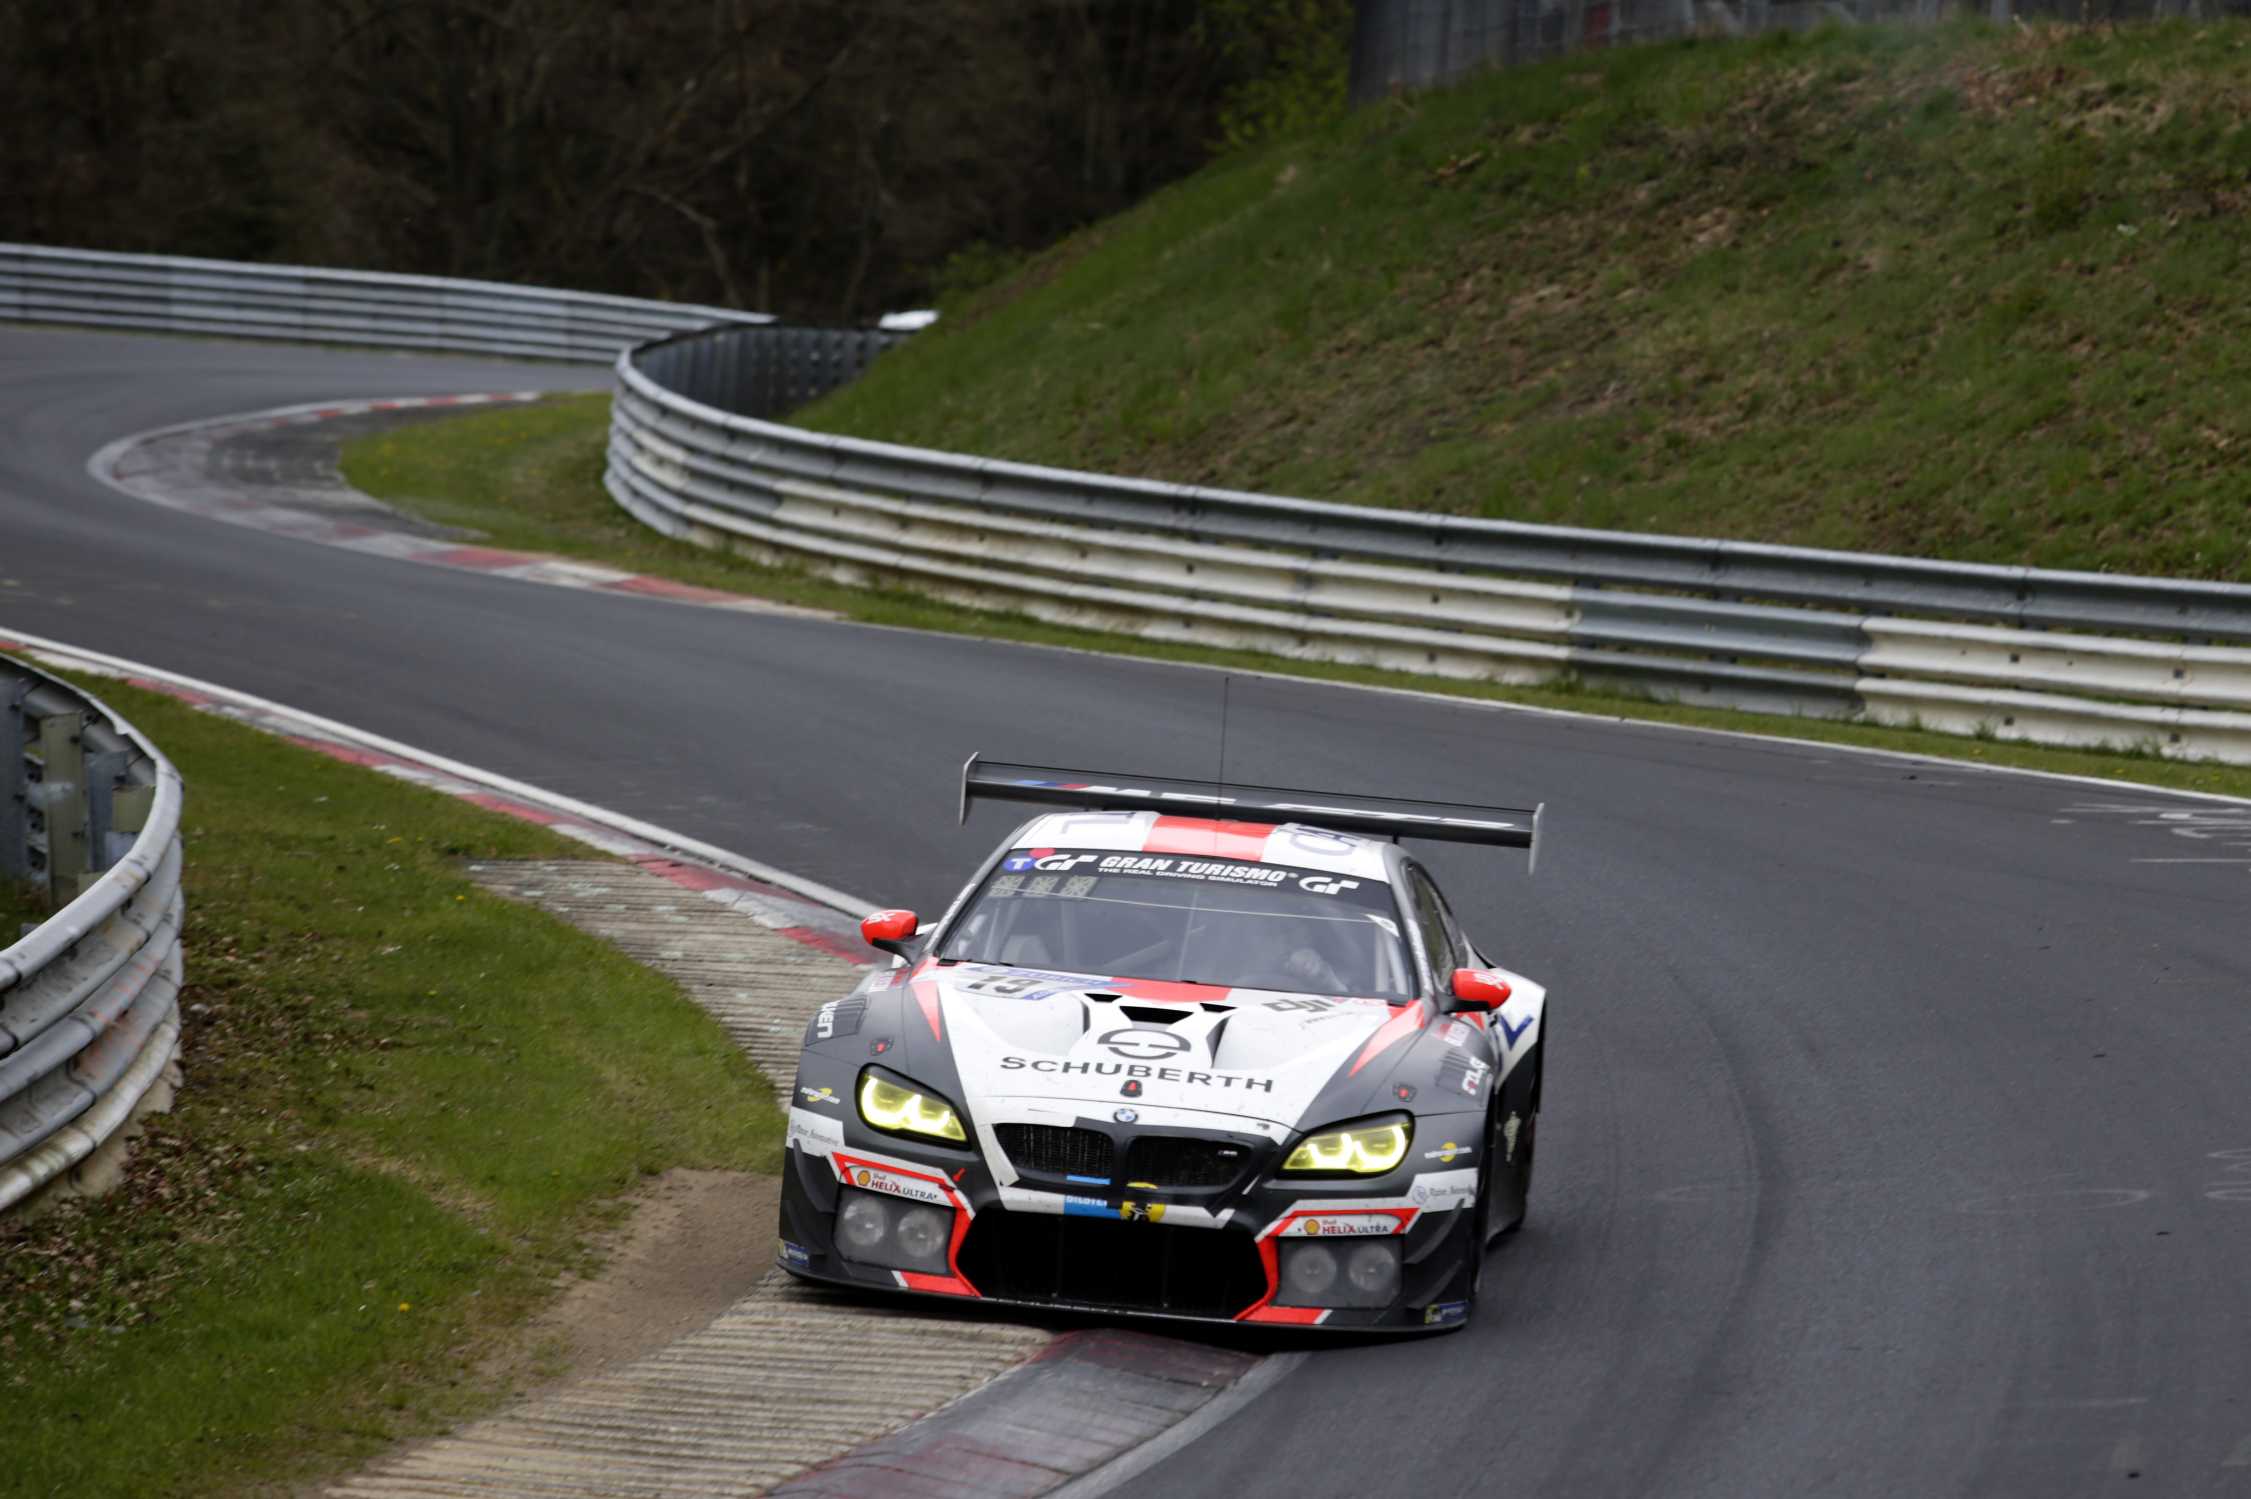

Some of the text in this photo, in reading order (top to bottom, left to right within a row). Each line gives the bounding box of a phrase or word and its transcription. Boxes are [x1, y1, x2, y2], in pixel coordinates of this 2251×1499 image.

[1099, 856, 1174, 871] GRAN
[1000, 1056, 1275, 1093] SCHUBERTH
[871, 1180, 933, 1200] HELIX ULTRA
[1322, 1225, 1389, 1234] HELIX ULTRA
